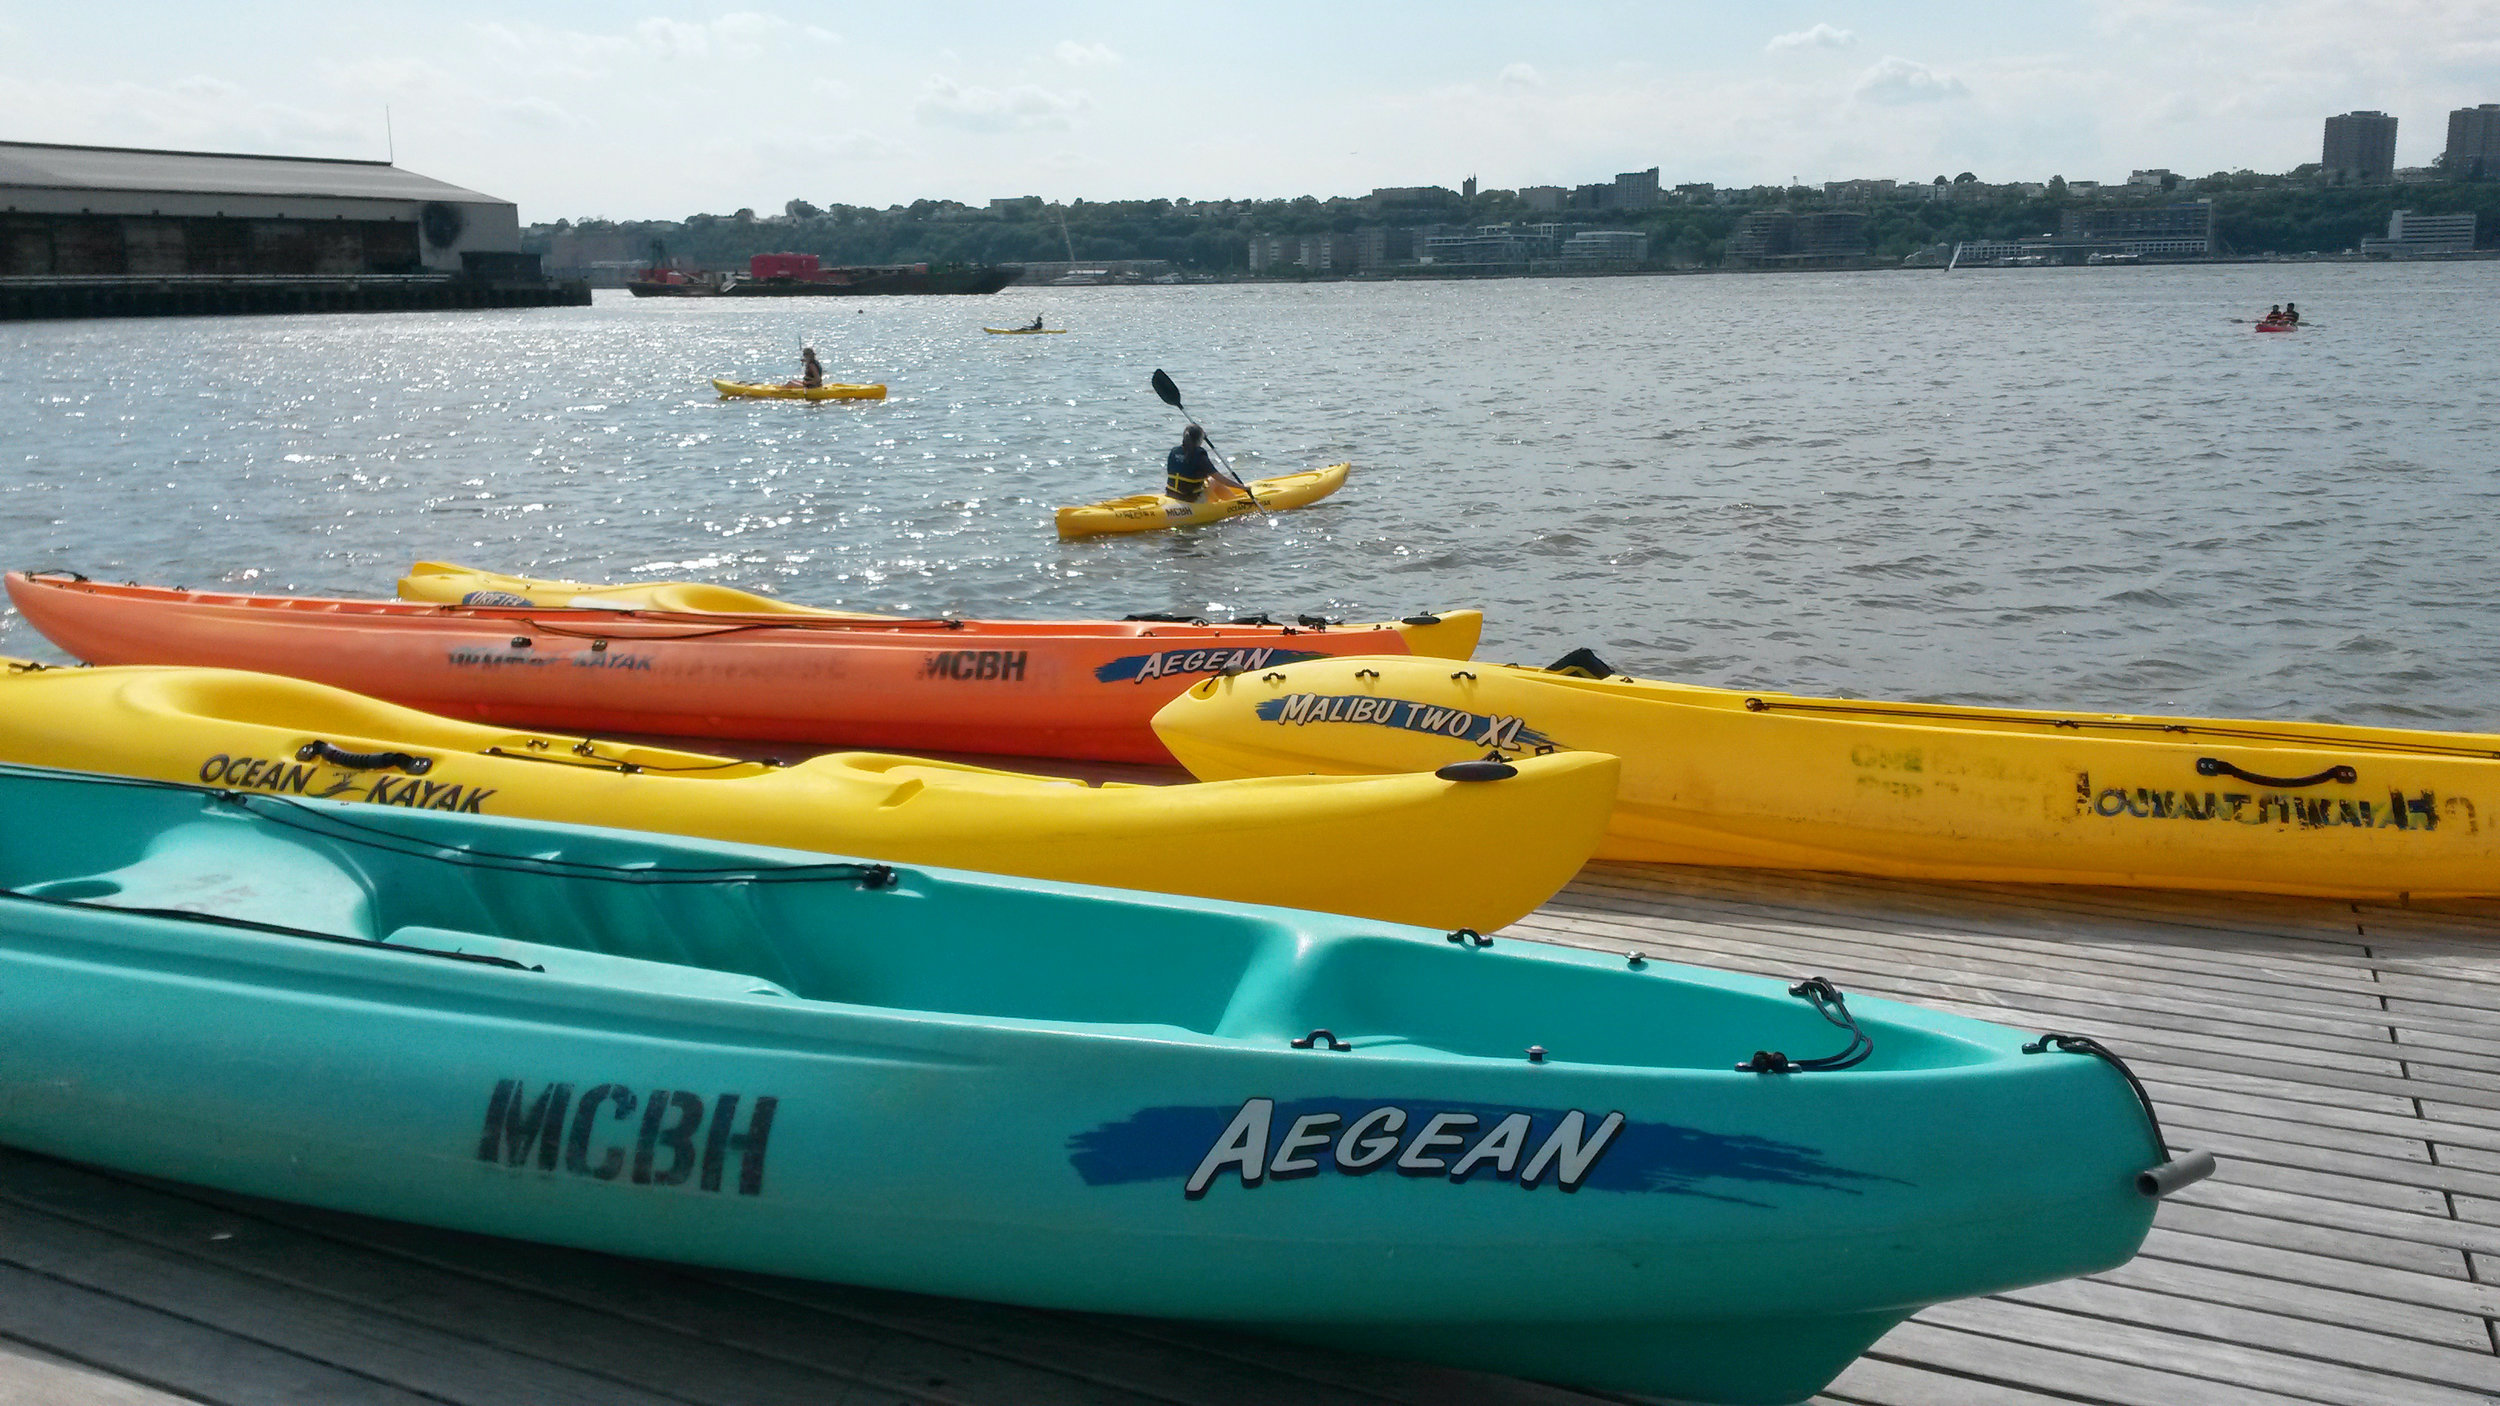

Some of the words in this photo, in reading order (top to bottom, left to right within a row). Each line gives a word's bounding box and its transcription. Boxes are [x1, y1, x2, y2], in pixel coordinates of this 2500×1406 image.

[915, 651, 1027, 681] MCBH
[1134, 647, 1274, 684] AEGEAN
[1278, 692, 1398, 726] MALIBU
[1400, 703, 1473, 738] TWO
[1475, 714, 1525, 751] XL
[199, 753, 318, 795] OCEAN
[365, 775, 498, 814] KAYAK
[477, 1079, 779, 1195] MCBH
[1184, 1097, 1626, 1201] AEGEAN
